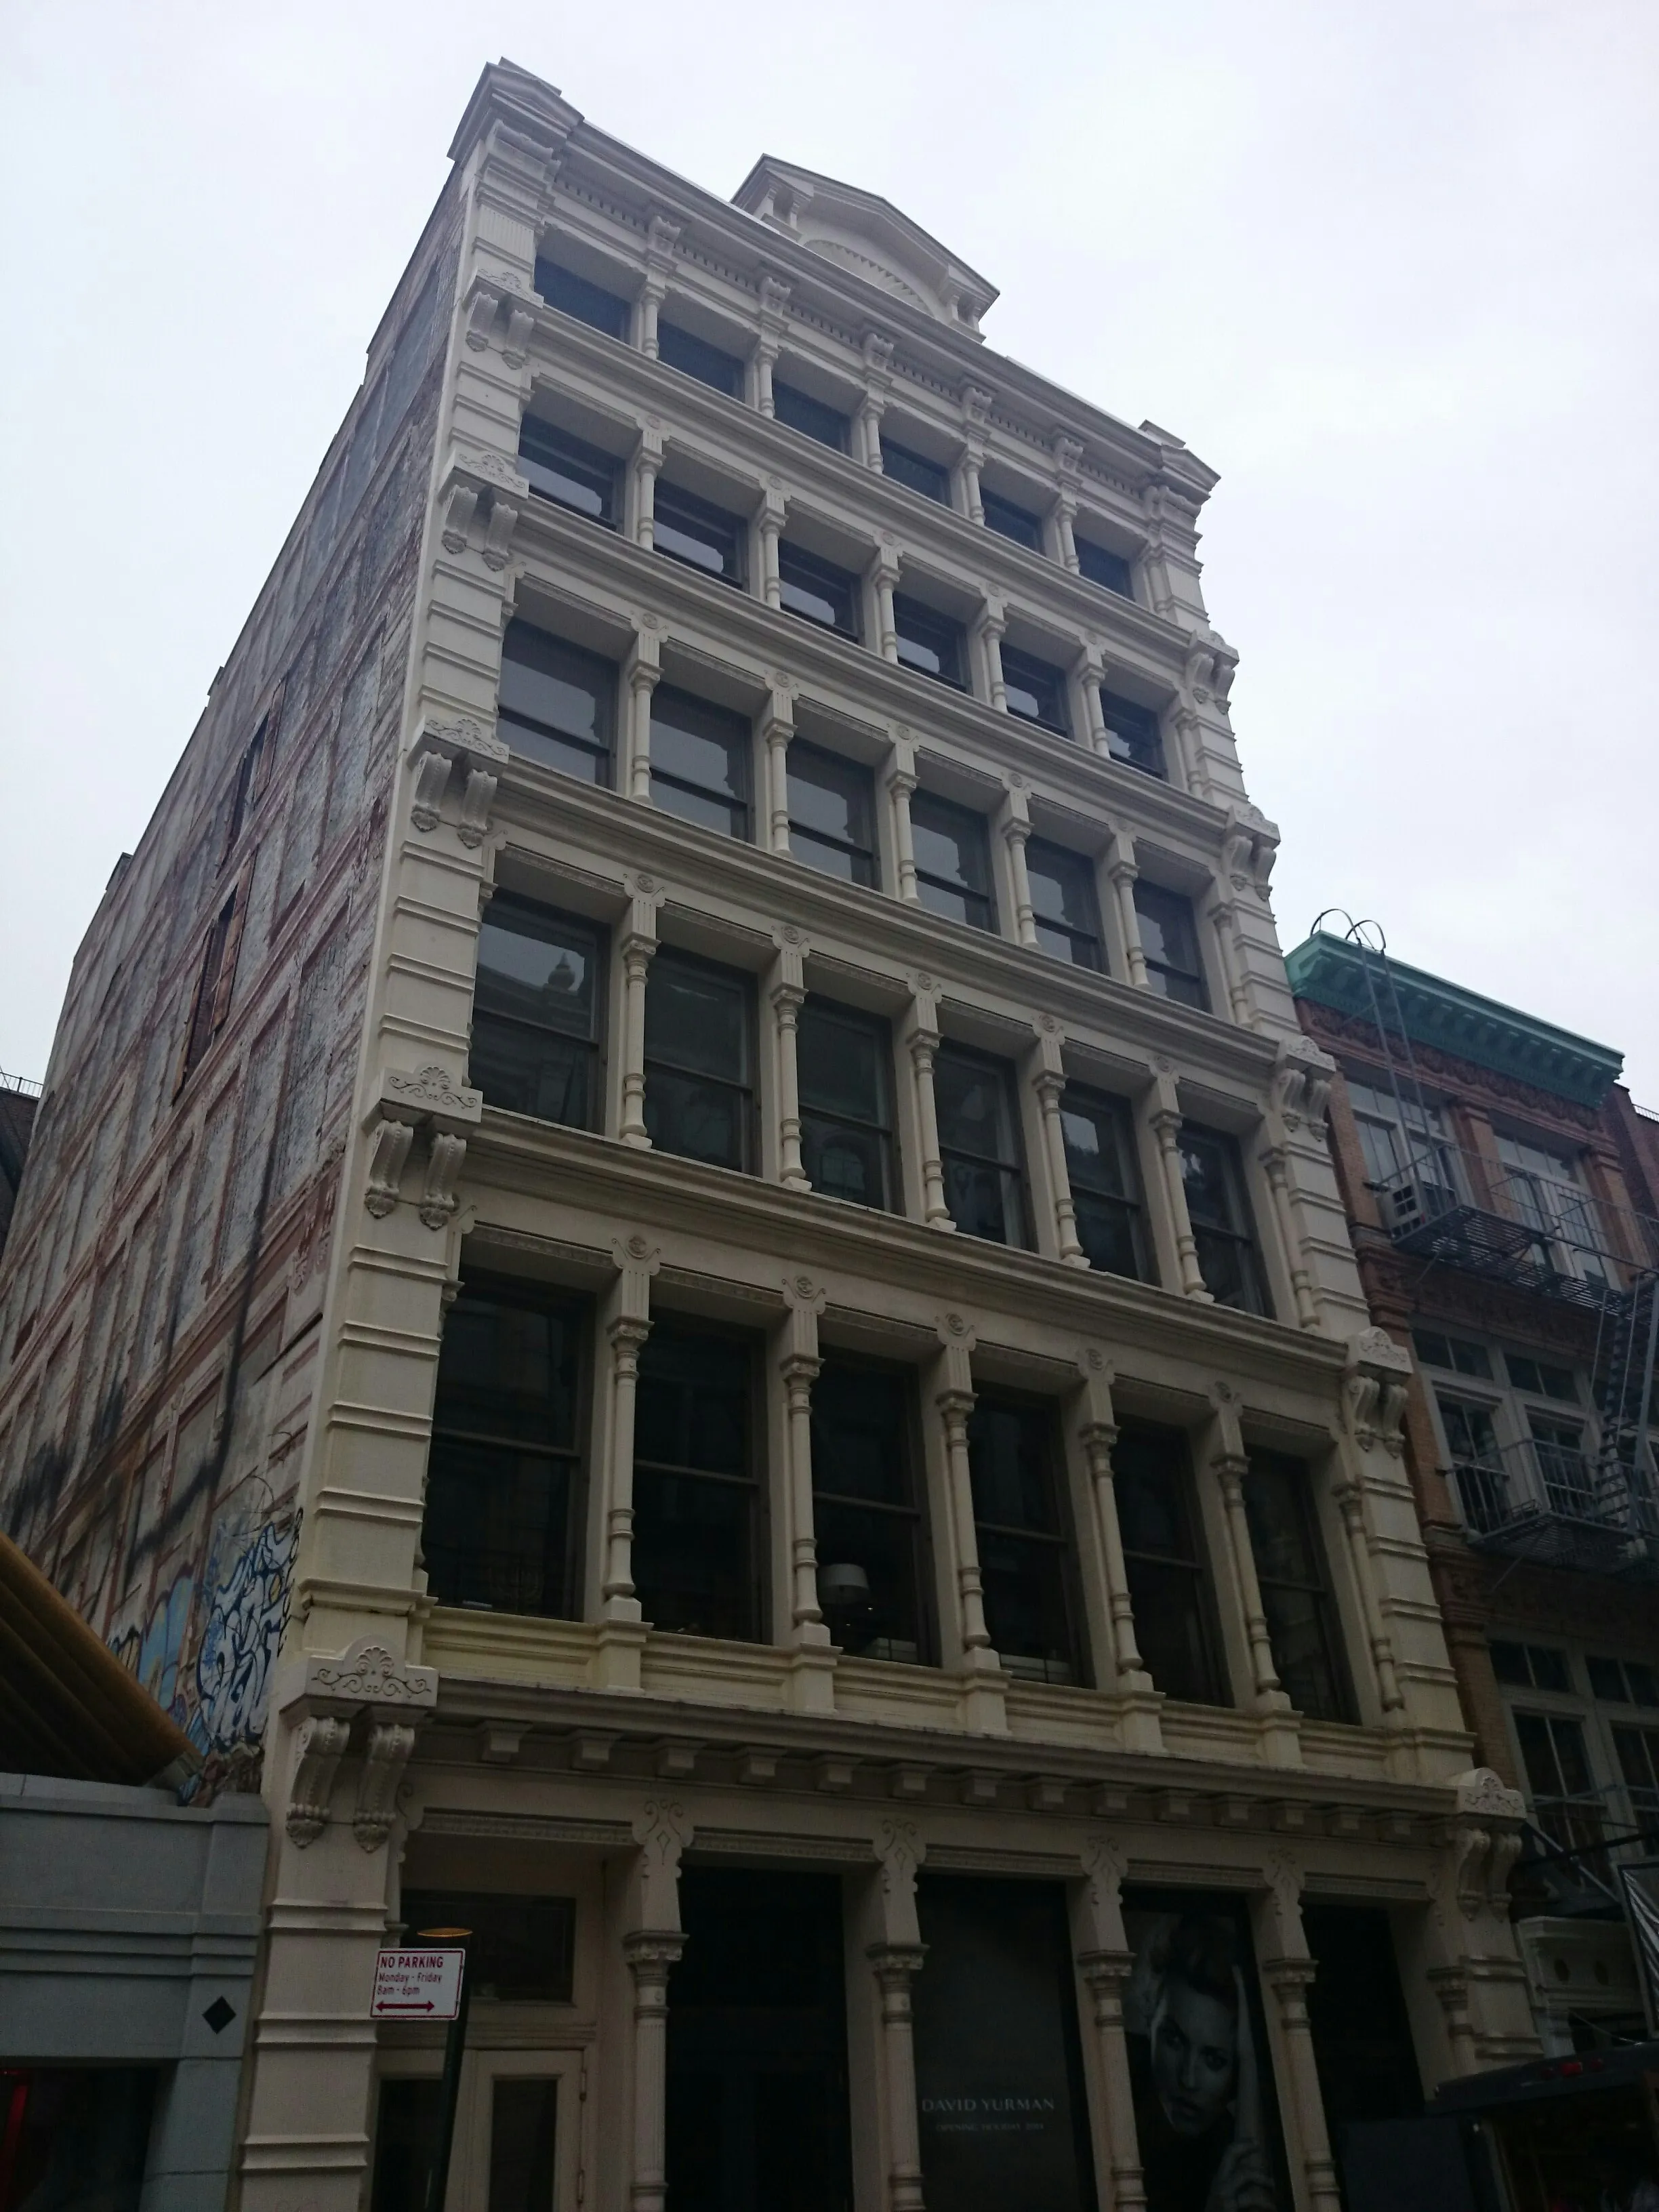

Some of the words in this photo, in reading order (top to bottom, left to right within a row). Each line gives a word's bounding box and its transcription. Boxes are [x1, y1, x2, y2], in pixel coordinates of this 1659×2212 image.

[380, 1956, 395, 1968] NO
[398, 1956, 444, 1968] PARKING
[378, 1971, 410, 1984] Monday
[417, 1971, 443, 1984] Friday
[922, 2098, 977, 2112] DAVID
[981, 2097, 1055, 2112] YURMAN
